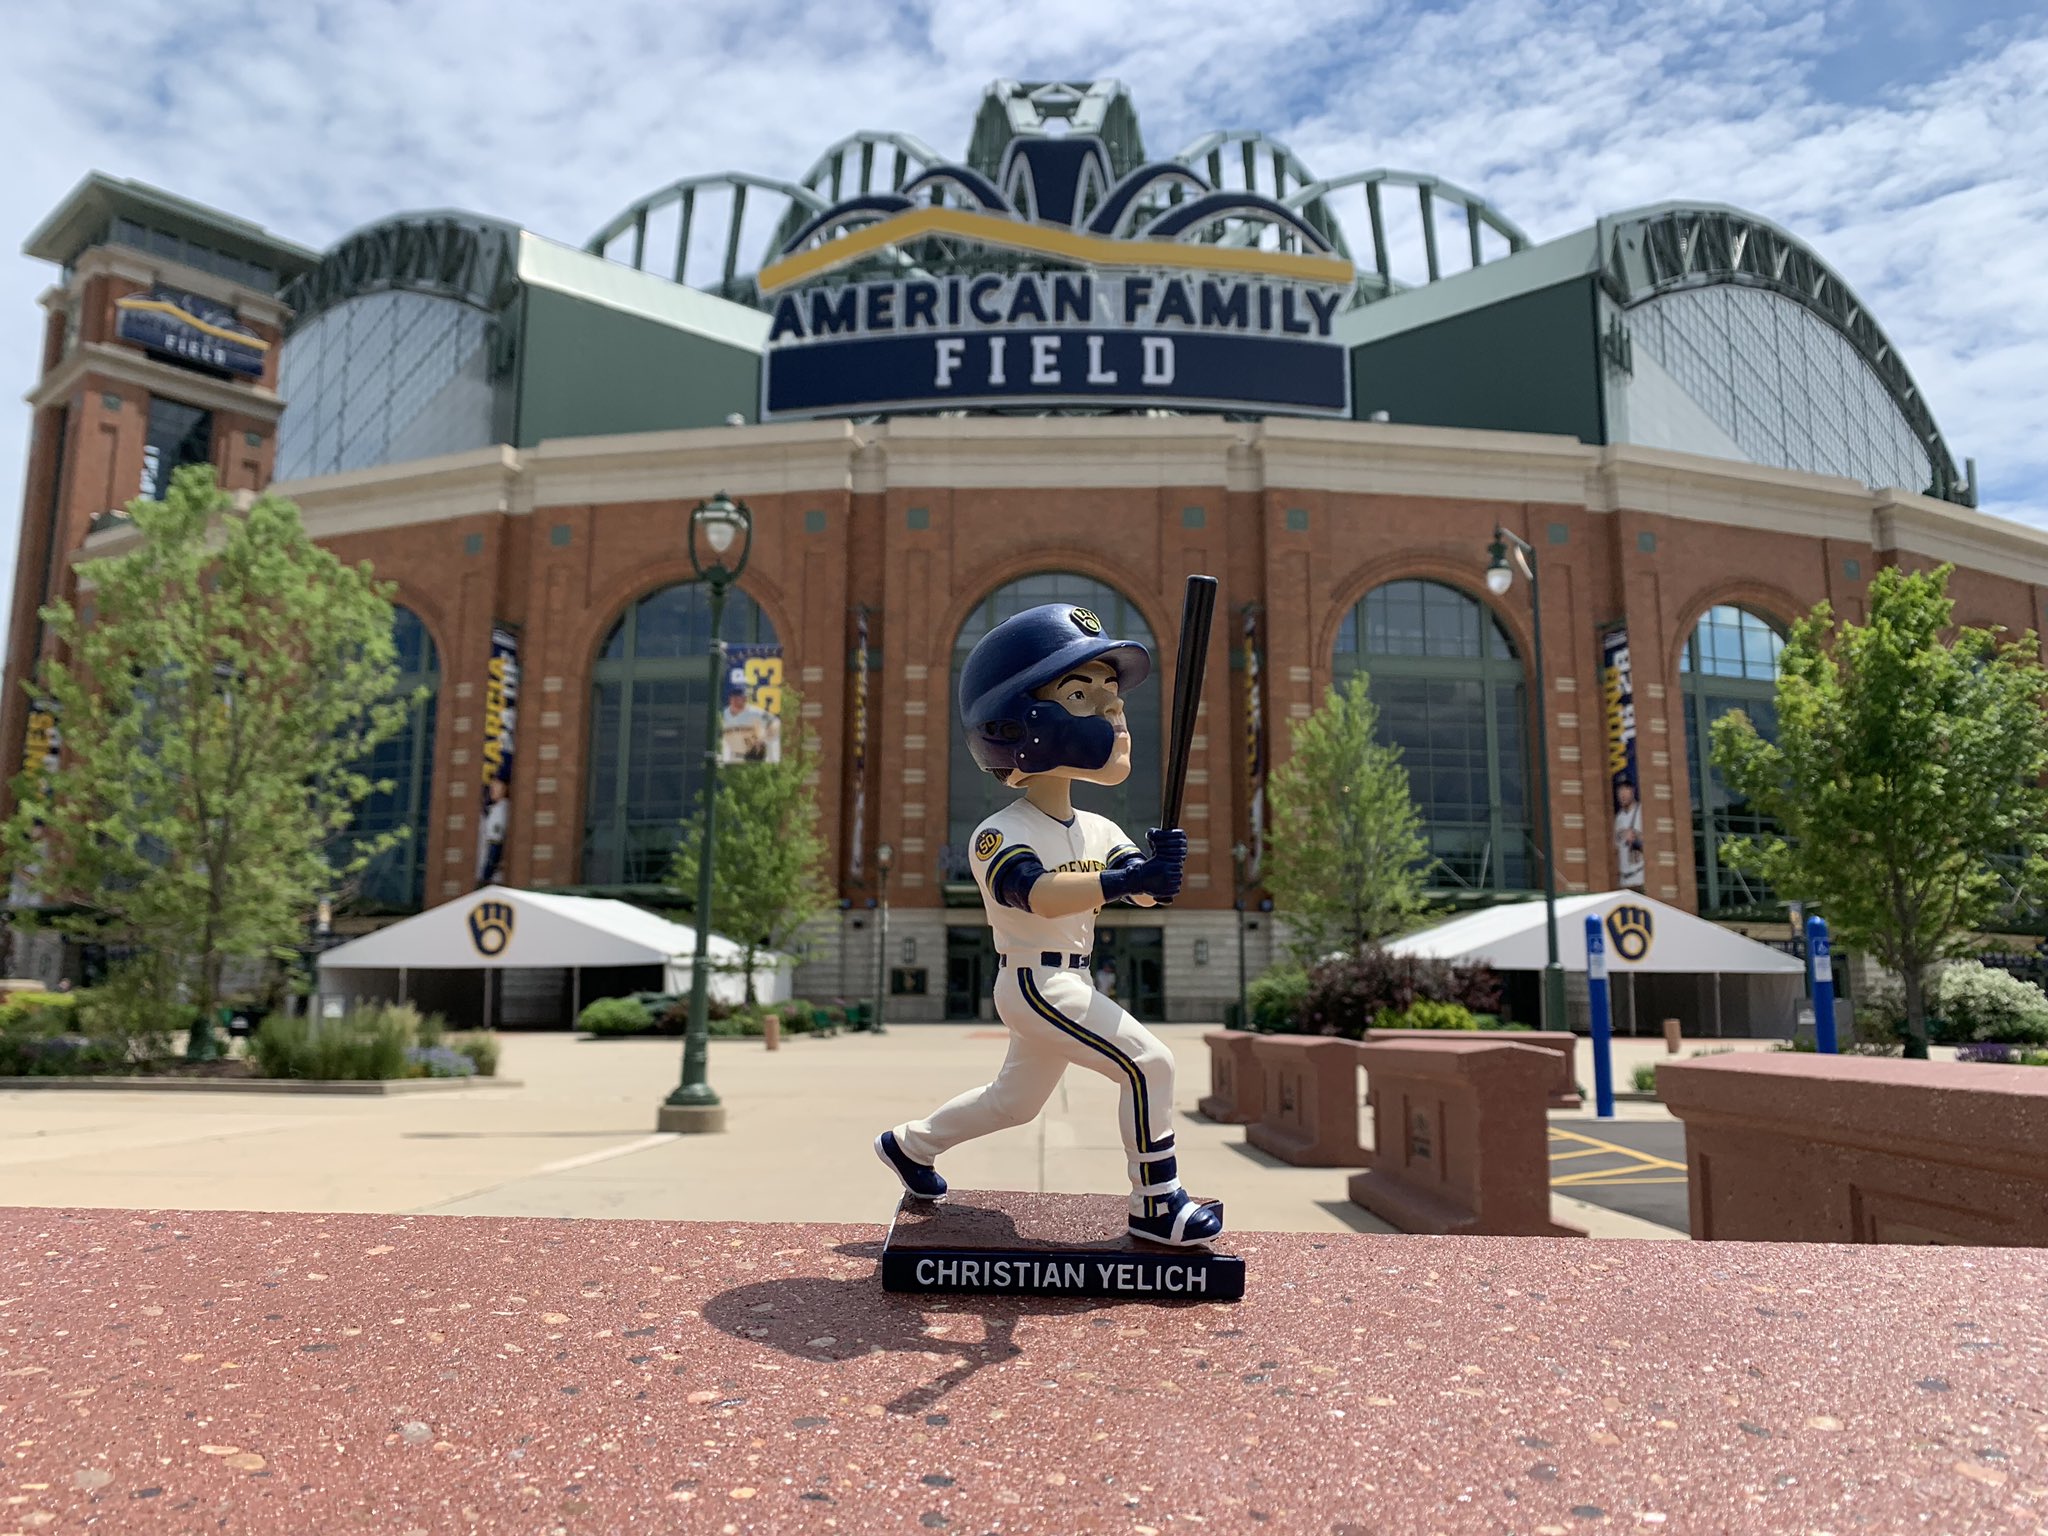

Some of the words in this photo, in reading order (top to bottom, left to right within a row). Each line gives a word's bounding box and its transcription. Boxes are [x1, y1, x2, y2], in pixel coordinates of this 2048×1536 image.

[769, 273, 1095, 342] AMERICAN
[1123, 278, 1342, 337] FAMILY
[935, 337, 1176, 387] FIELD
[915, 1258, 1085, 1288] CHRISTIAN
[1096, 1263, 1208, 1293] YELICH
